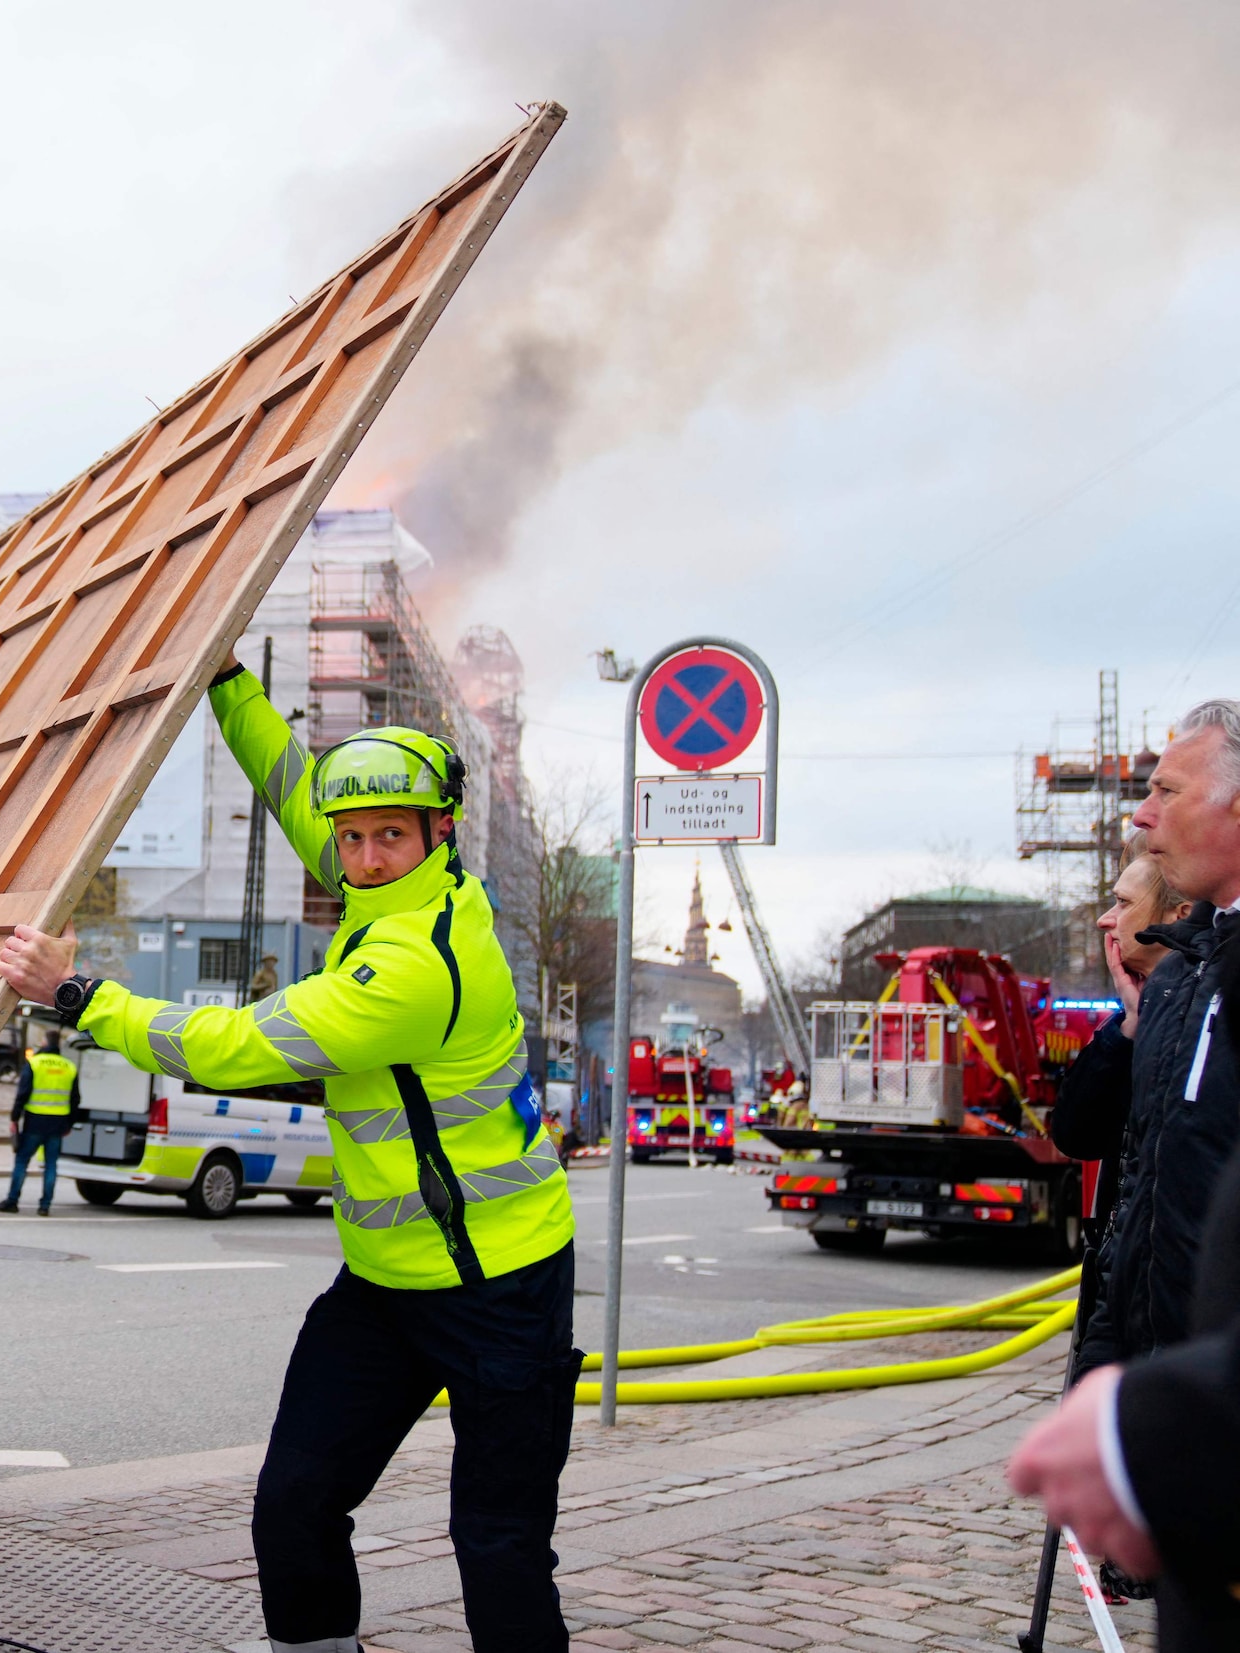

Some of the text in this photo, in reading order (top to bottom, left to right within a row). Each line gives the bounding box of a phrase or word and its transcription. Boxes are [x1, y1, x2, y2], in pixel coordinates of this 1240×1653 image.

[322, 774, 411, 801] AMBULANCE
[680, 788, 728, 800] Ud- og
[665, 803, 744, 815] indstigning
[682, 818, 726, 829] tilladt
